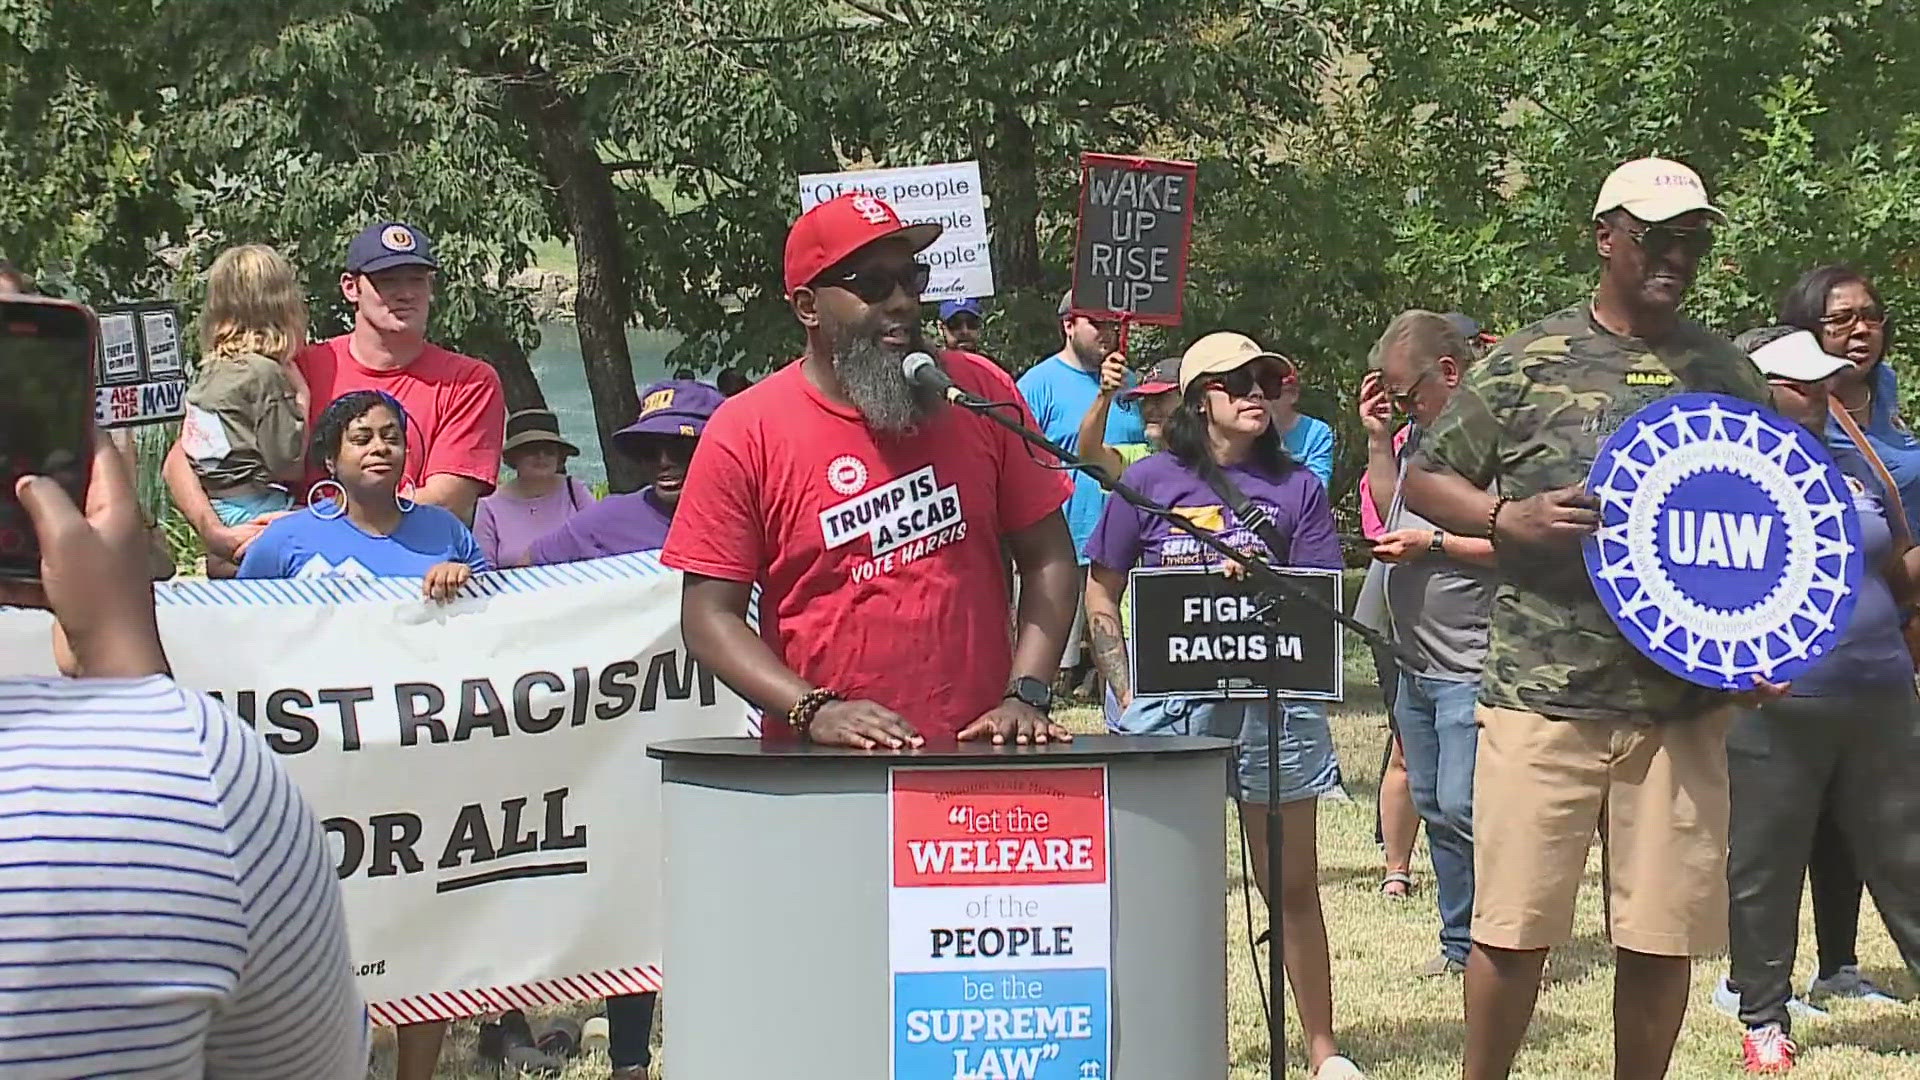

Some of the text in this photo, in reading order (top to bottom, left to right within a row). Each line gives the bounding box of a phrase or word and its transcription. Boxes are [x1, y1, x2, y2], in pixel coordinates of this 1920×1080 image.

[893, 178, 969, 204] people
[1088, 167, 1183, 212] WAKE
[1112, 210, 1156, 242] UP
[914, 243, 986, 269] eople”
[1091, 243, 1169, 282] RISE
[1107, 281, 1153, 313] UP
[111, 387, 138, 404] ARE
[1626, 373, 1674, 386] NAACP
[111, 402, 138, 419] THE
[142, 381, 184, 416] MANY
[826, 475, 933, 538] TRUMP IS
[877, 496, 957, 549] A SCAB
[852, 522, 967, 583] VOTE HARRIS
[1668, 508, 1773, 570] UAW
[1168, 634, 1304, 664] RACISM
[394, 649, 716, 747] RACISM
[320, 787, 587, 880] OR ALL
[1007, 806, 1049, 832] the
[907, 837, 1093, 874] WELFARE
[966, 894, 1039, 918] of the
[930, 926, 1073, 958] PEOPLE
[963, 975, 1043, 1000] be the
[906, 1005, 1092, 1043] SUPREME
